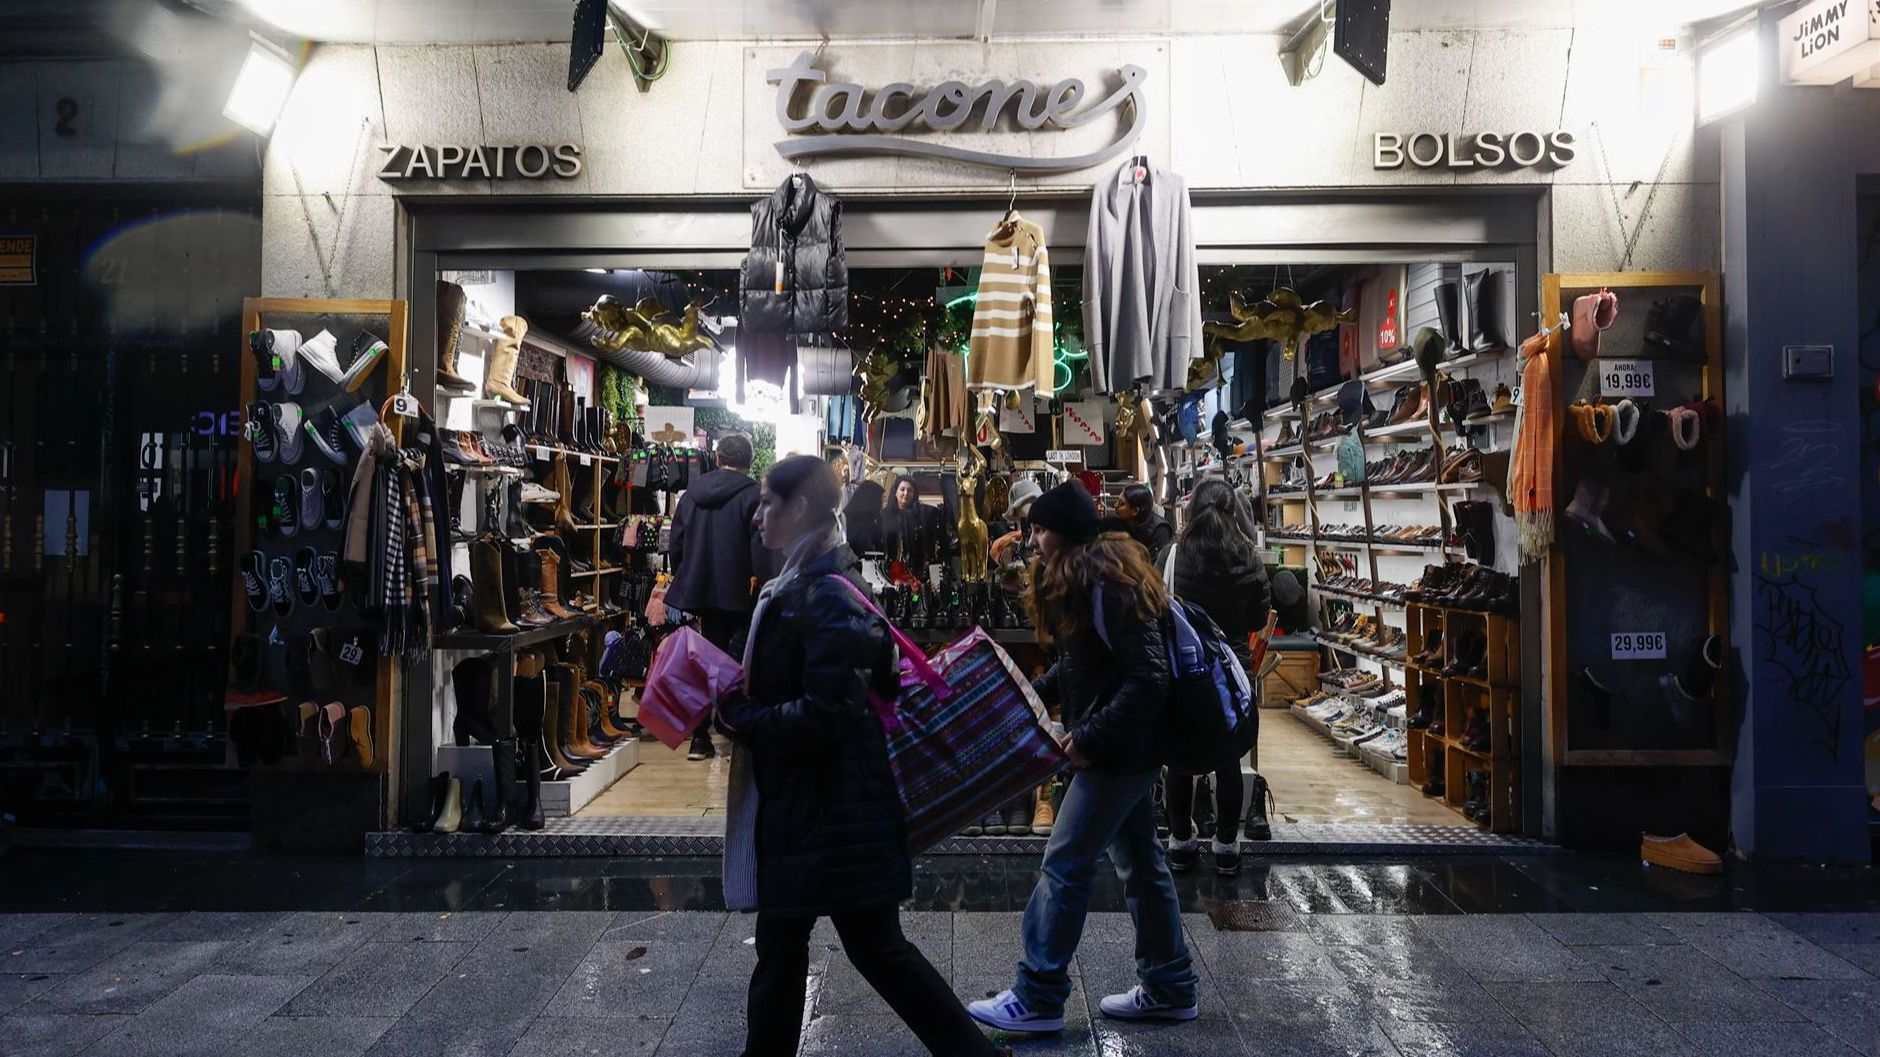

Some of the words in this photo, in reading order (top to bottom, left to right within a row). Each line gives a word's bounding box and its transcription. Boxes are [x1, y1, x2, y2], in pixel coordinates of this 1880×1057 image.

[766, 50, 1148, 171] tacones
[1374, 131, 1577, 169] BOLSOS
[376, 143, 583, 179] ZAPATOS
[1380, 329, 1395, 344] 10%
[1614, 363, 1637, 372] AHORA:
[1605, 373, 1651, 390] 19,99€
[1615, 635, 1663, 653] 29,99€
